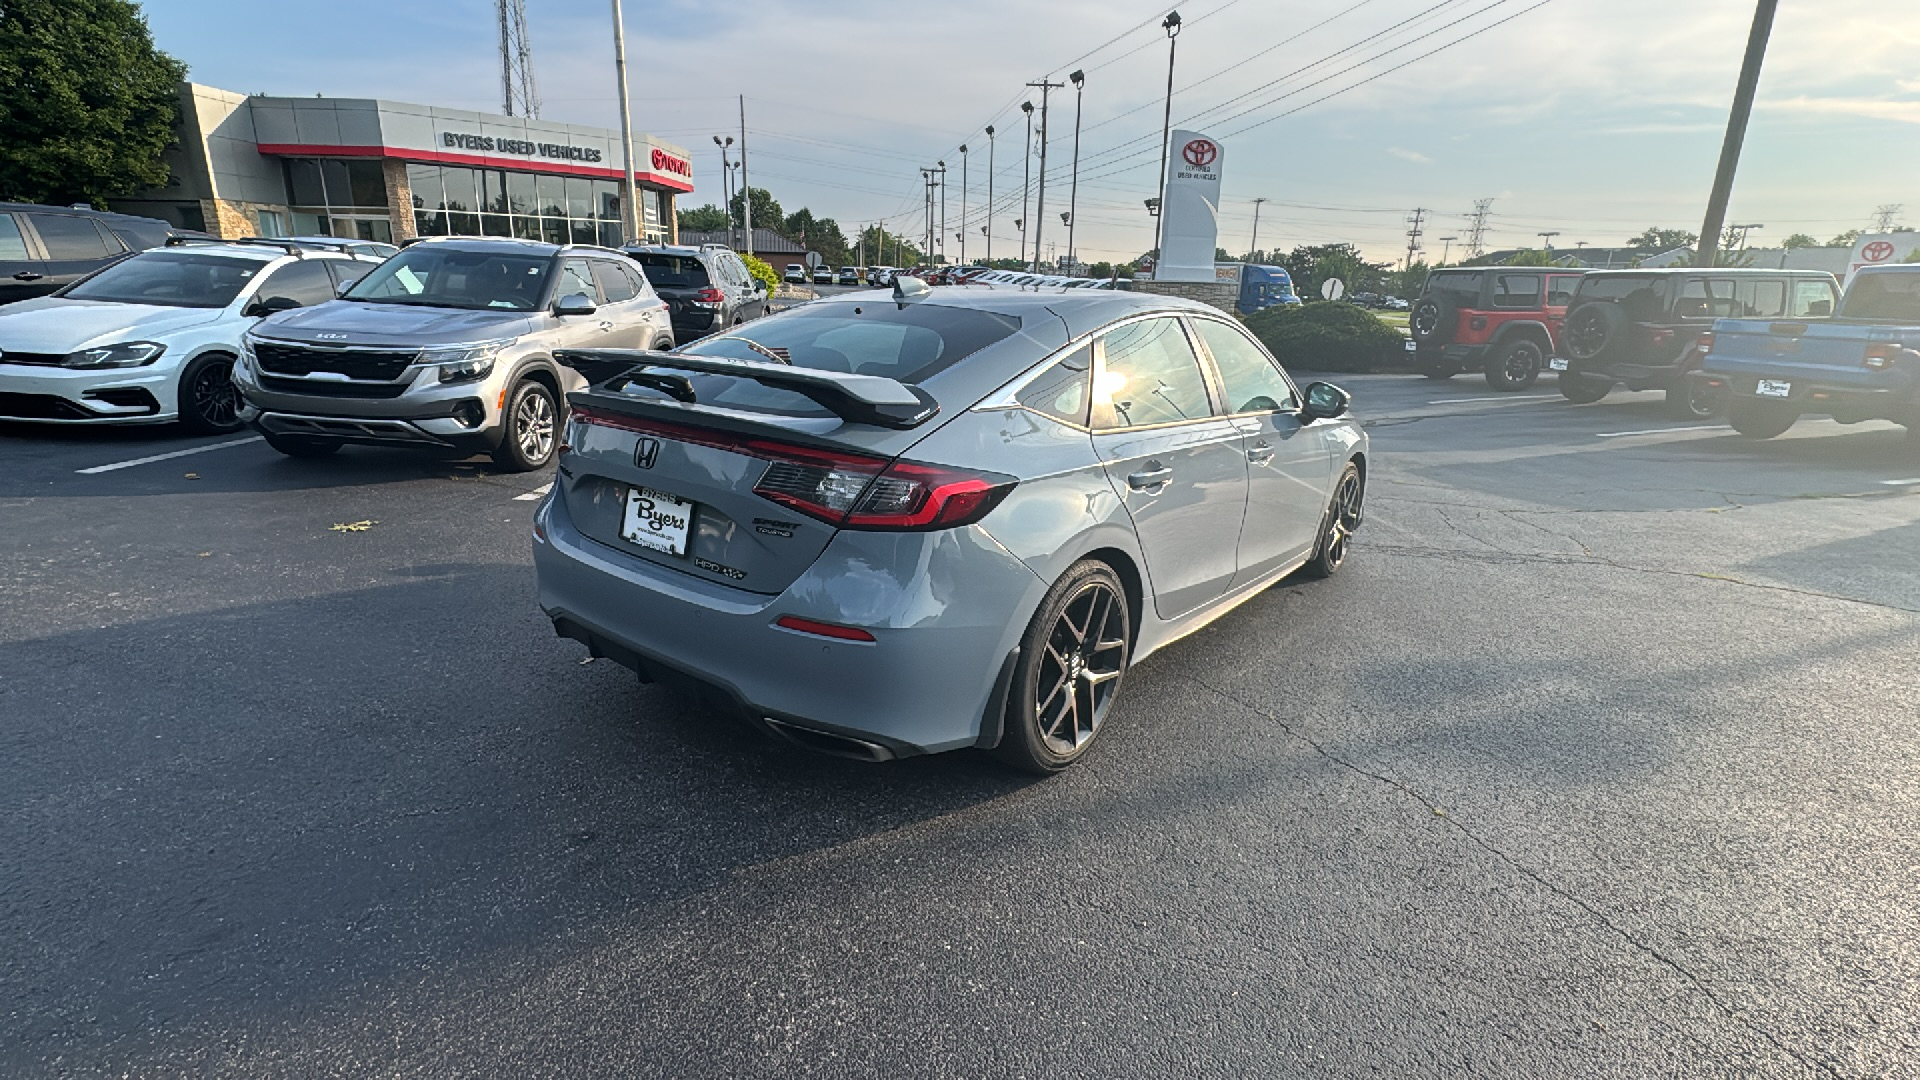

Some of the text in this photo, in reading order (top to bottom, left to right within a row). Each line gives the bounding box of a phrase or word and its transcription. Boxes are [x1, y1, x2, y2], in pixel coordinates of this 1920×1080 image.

[443, 131, 602, 163] BYERS USED VEHICLES
[1177, 171, 1217, 181] USED VEHICLES
[632, 497, 685, 531] Byers
[752, 517, 802, 529] SPORT
[695, 557, 720, 573] HPD
